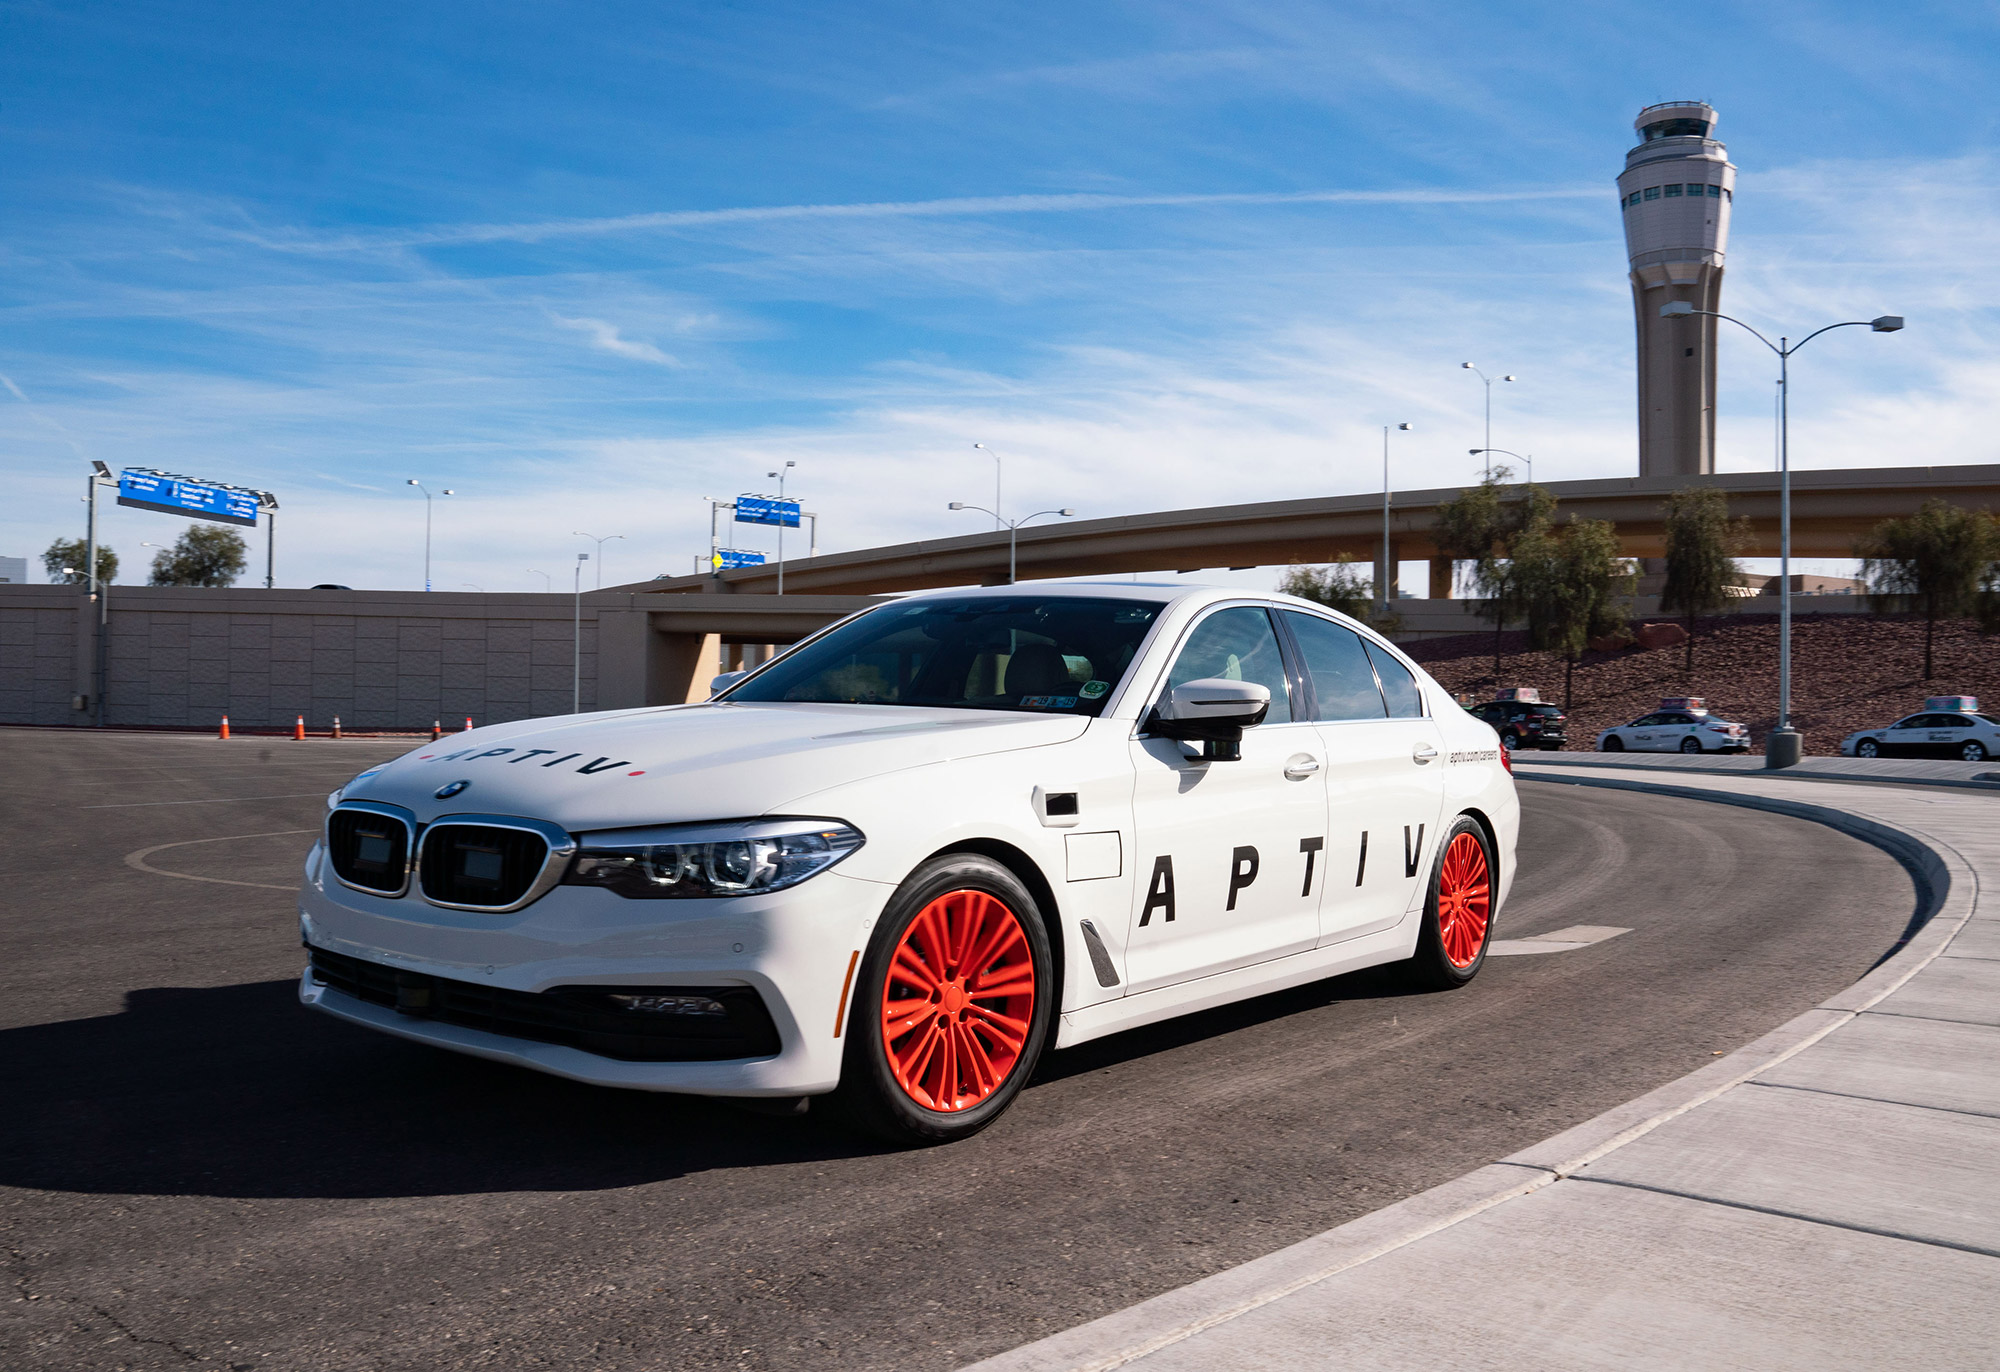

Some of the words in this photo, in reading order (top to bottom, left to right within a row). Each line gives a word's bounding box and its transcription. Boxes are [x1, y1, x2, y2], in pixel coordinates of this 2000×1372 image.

[426, 747, 633, 775] APTIV
[1450, 748, 1498, 767] aptiv.com/careers
[1138, 823, 1425, 928] APTIV
